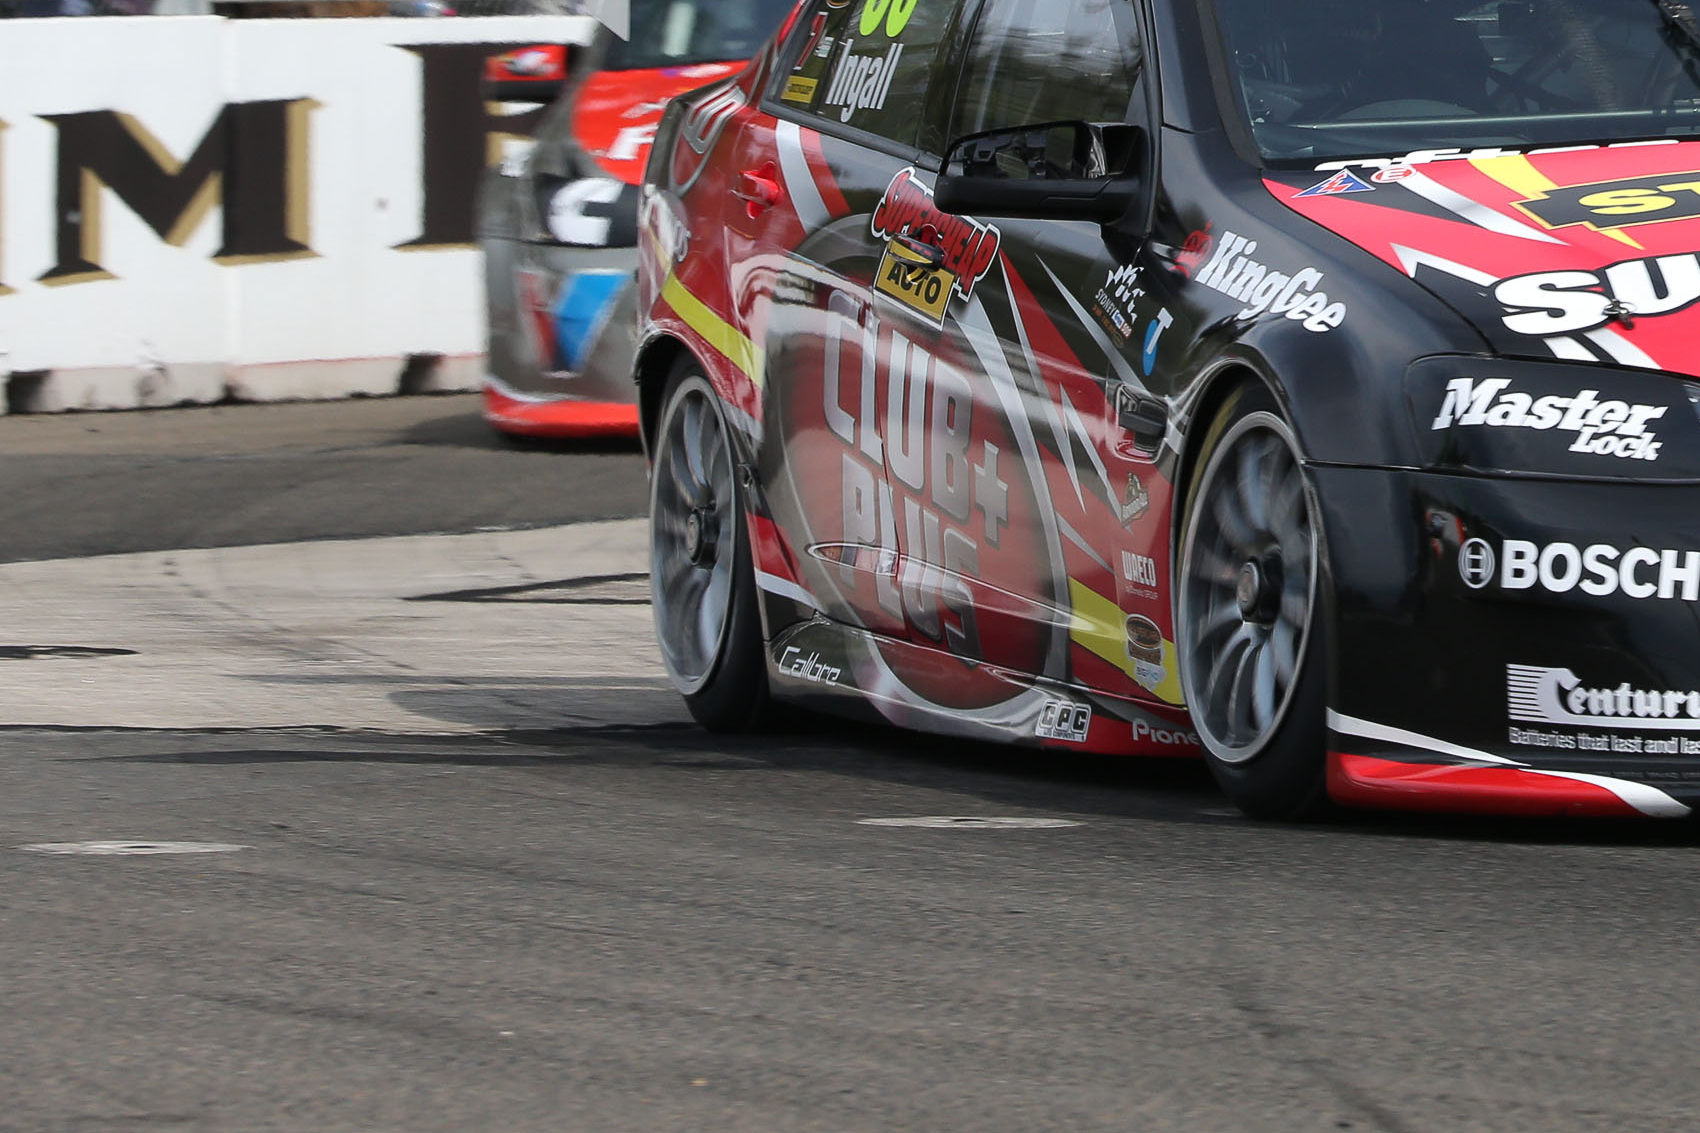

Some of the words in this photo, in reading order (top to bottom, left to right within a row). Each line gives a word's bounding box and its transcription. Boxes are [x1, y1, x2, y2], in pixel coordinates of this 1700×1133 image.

[825, 38, 904, 123] Ingall
[1095, 288, 1119, 318] SYDNEY
[1195, 230, 1347, 333] KingGee
[1431, 377, 1669, 436] Master
[1567, 426, 1663, 461] Lock
[838, 454, 985, 669] PLUS
[777, 645, 841, 687] Calibre
[1577, 732, 1610, 752] that
[1611, 734, 1644, 754] last
[1645, 736, 1678, 754] and
